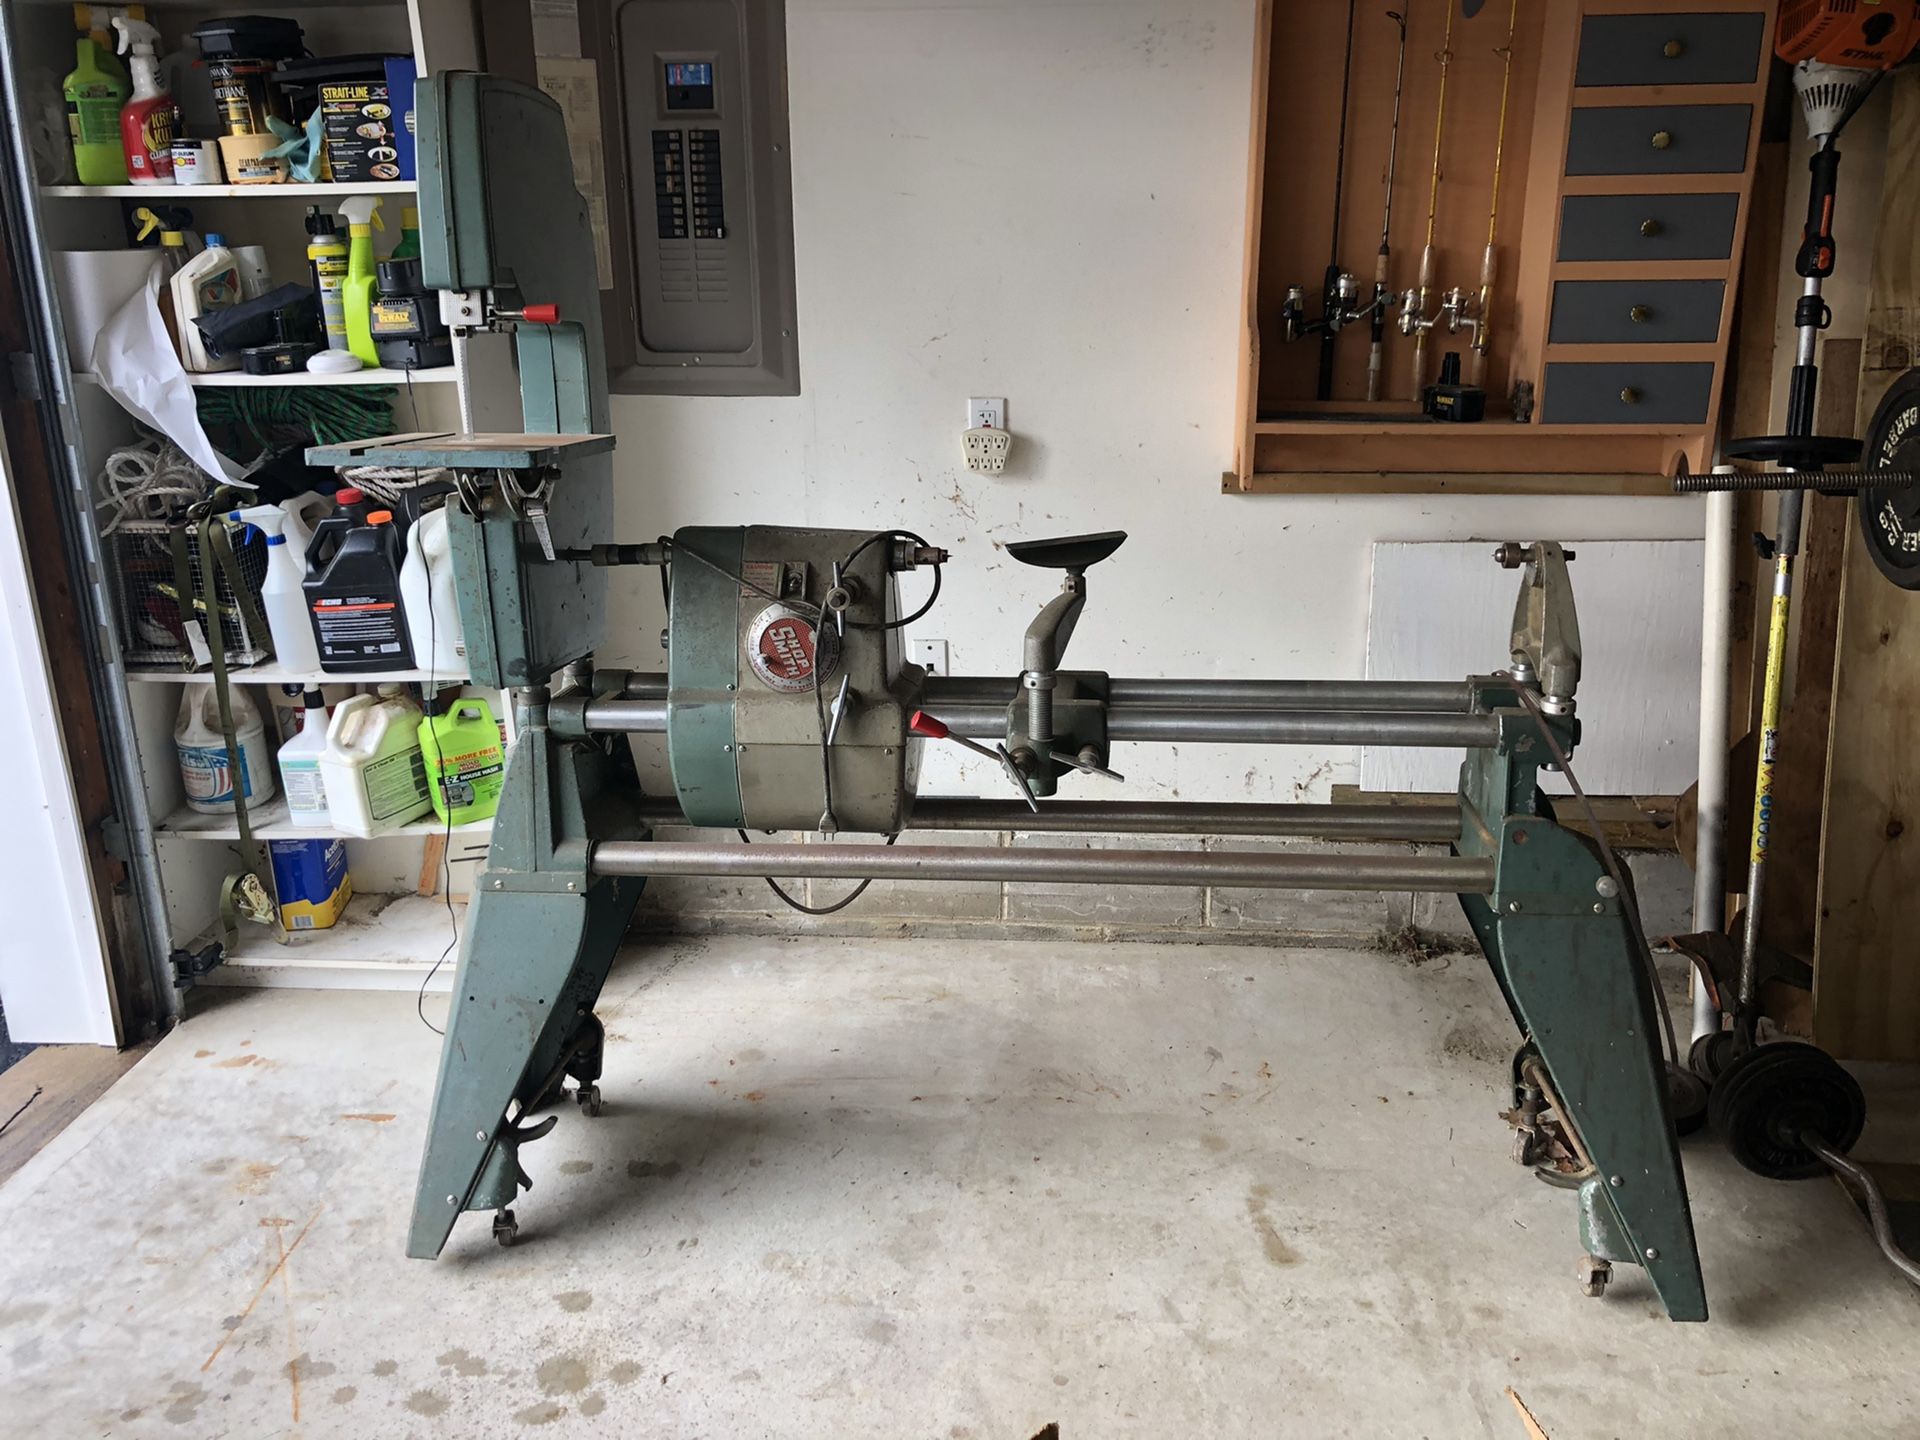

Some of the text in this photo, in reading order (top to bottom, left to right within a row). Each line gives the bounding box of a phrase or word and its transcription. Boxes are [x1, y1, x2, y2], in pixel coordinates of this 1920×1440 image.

[322, 86, 369, 99] STRAIT-LINE
[1879, 407, 1918, 468] BARBEL
[768, 628, 801, 676] SMITH
[772, 626, 810, 668] SHOP
[454, 751, 478, 762] MORE
[479, 746, 499, 756] FREE
[460, 770, 482, 781] HOUSE
[481, 765, 500, 776] WASH
